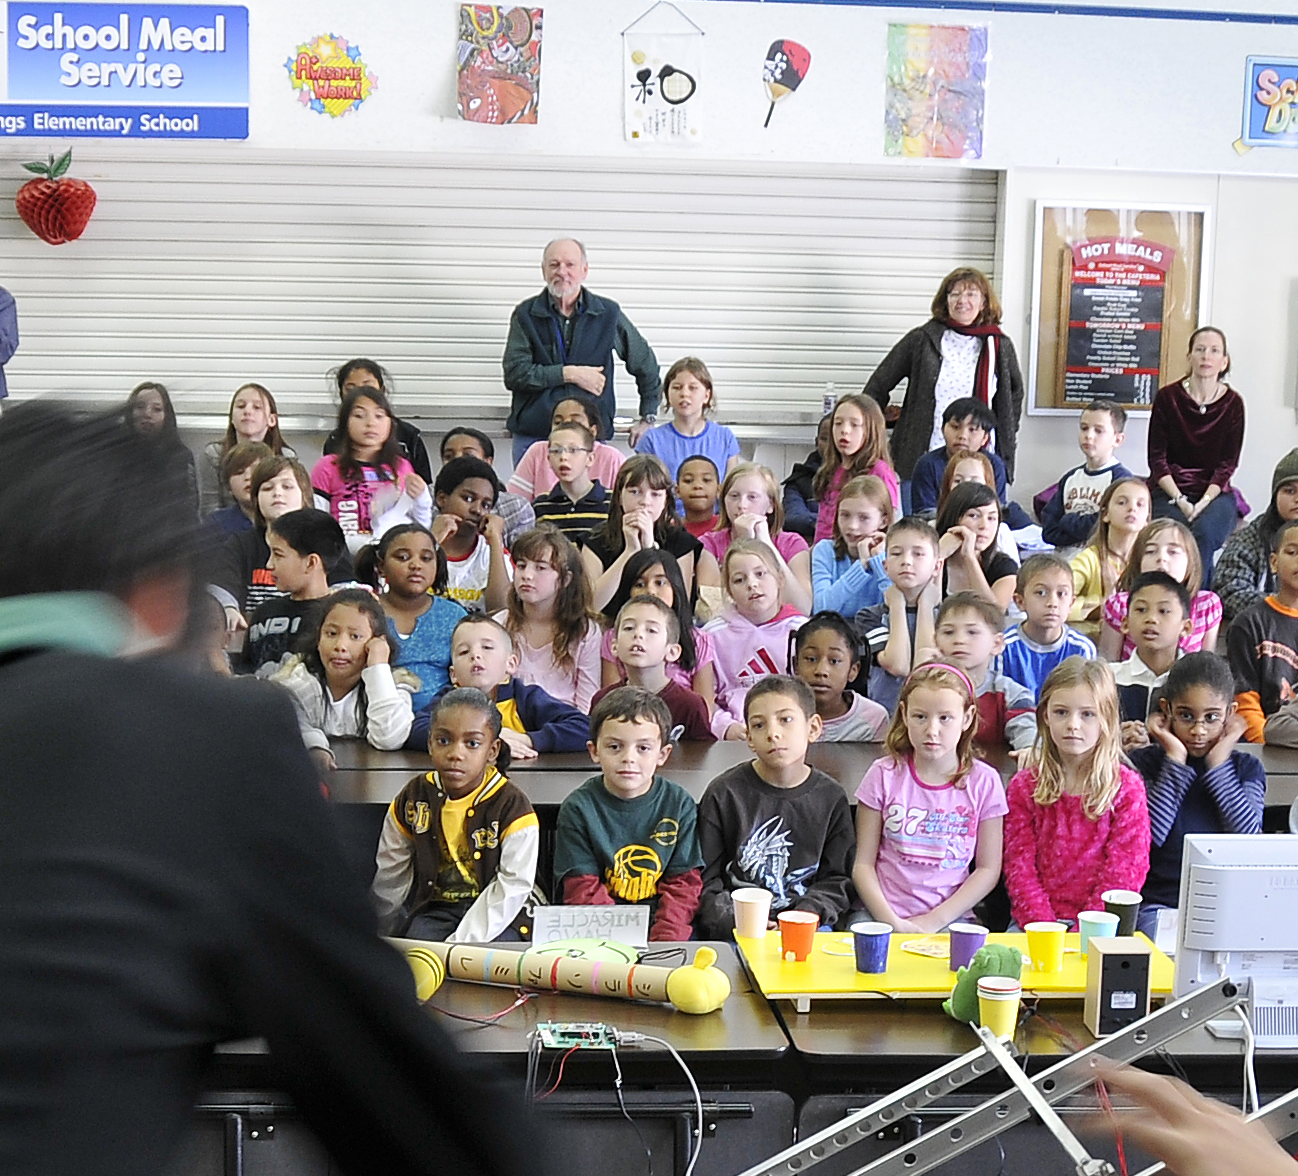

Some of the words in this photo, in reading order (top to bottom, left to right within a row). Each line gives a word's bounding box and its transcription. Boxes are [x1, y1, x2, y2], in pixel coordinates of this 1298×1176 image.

[16, 12, 129, 50] School
[138, 14, 226, 52] Meal
[59, 52, 183, 88] Service
[33, 112, 133, 134] Elementary
[139, 114, 199, 132] School
[1081, 243, 1111, 259] HOT
[1115, 242, 1163, 263] MEALS
[1127, 272, 1161, 280] CAFETERIA
[1085, 321, 1127, 329] TOMORROW'S
[1127, 322, 1146, 330] MENU
[884, 802, 929, 836] 27
